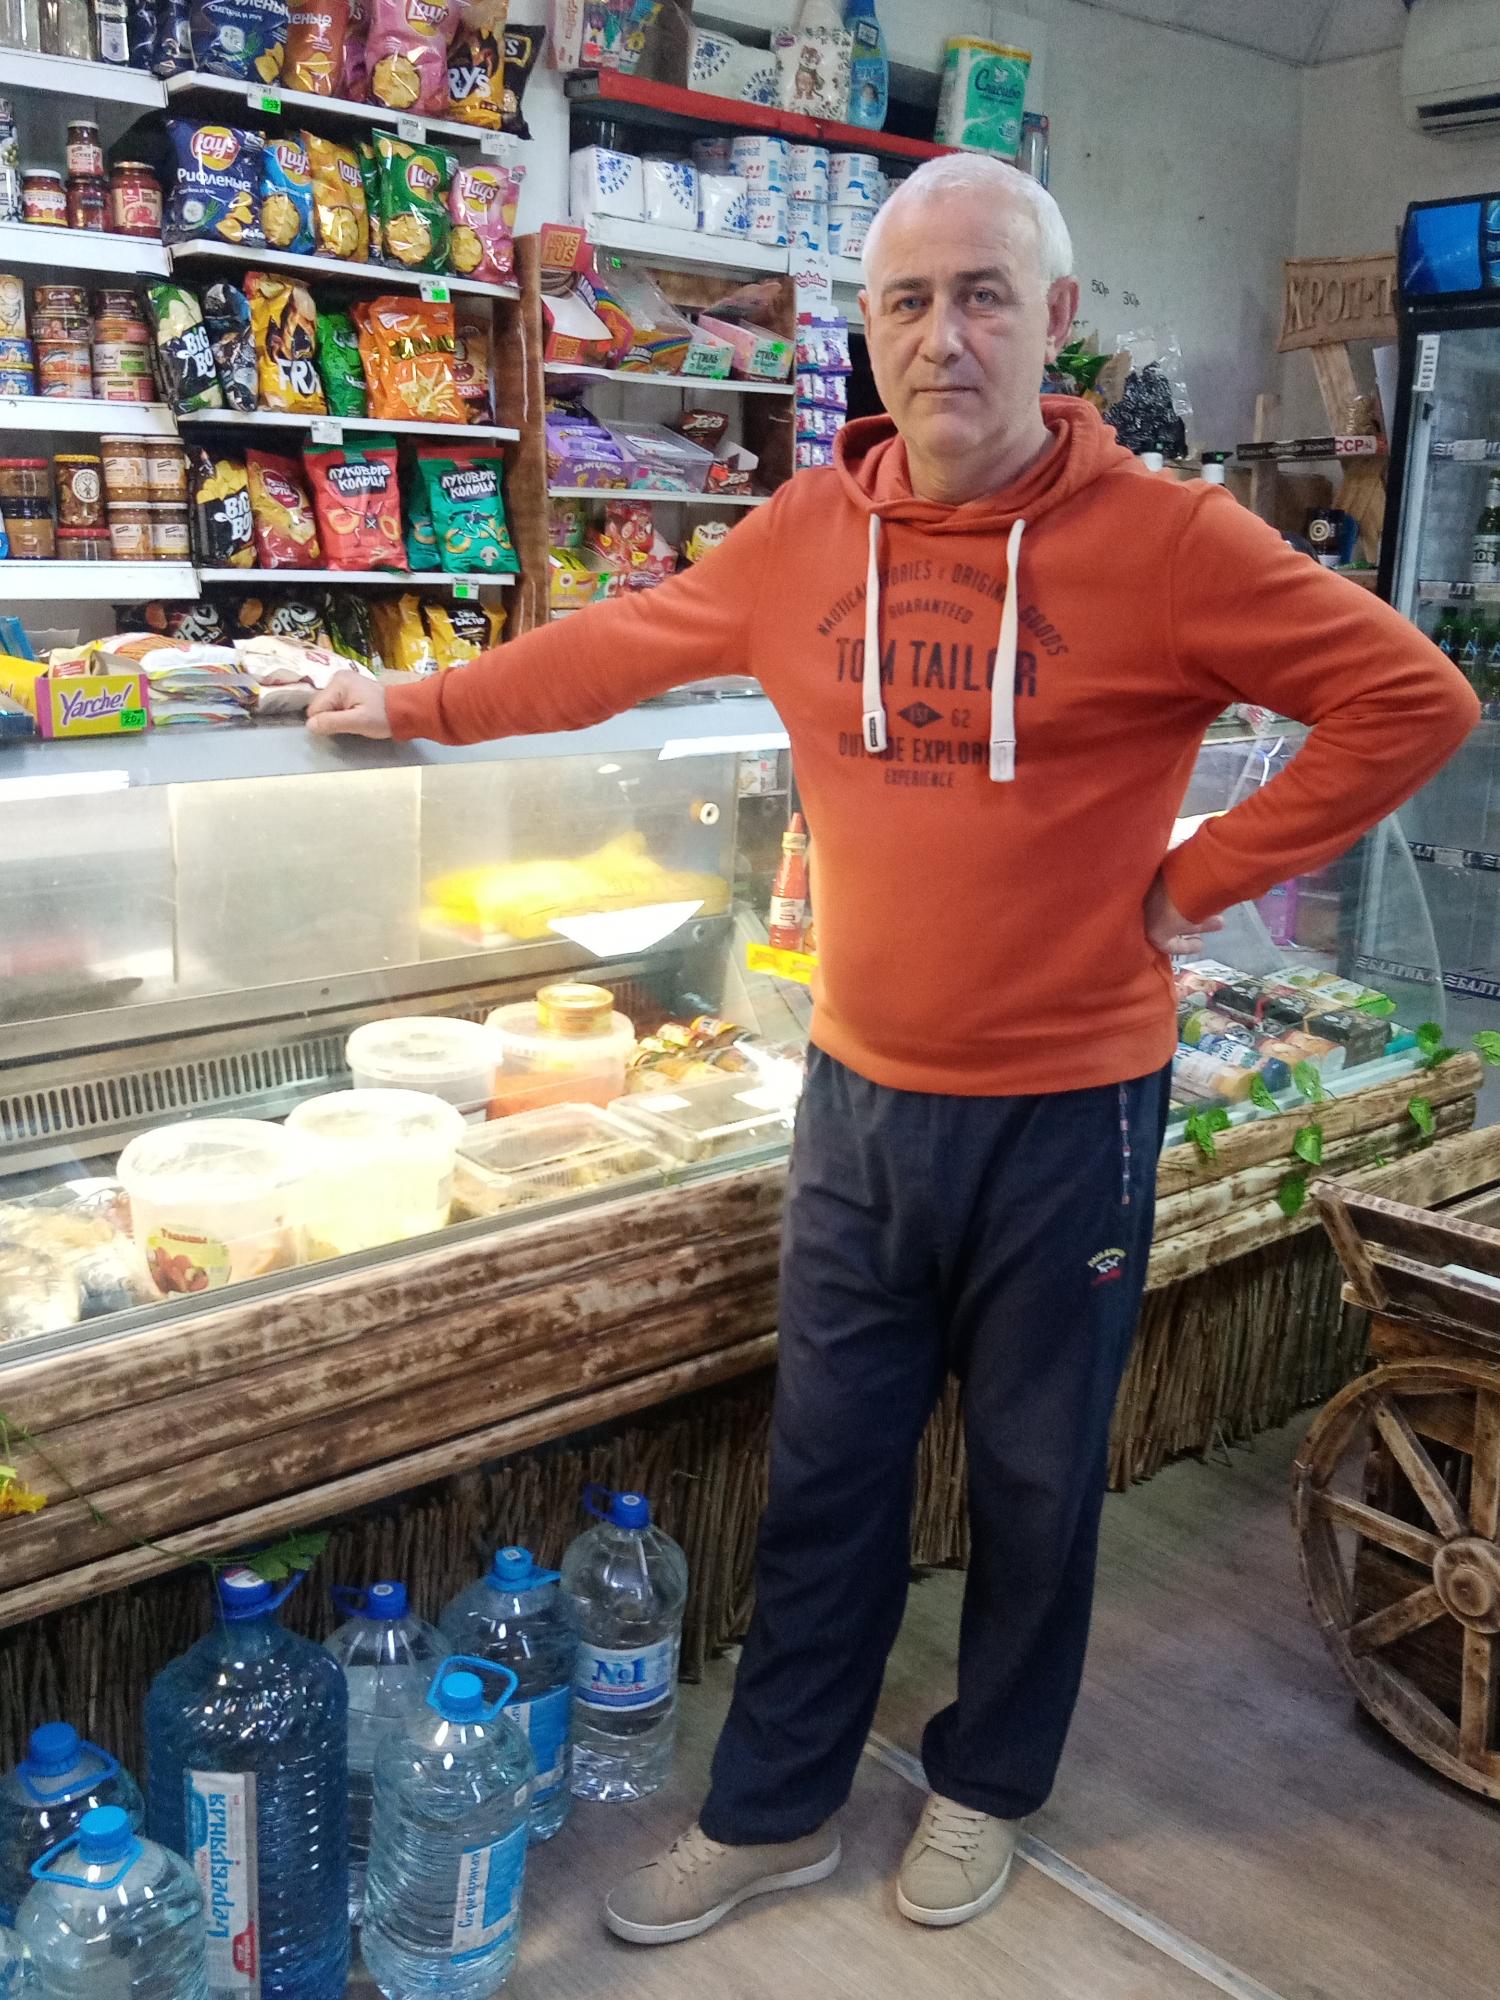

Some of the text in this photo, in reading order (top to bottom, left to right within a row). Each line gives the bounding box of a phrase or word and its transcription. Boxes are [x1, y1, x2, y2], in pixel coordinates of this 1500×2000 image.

[328, 464, 391, 482] ЛУКОВЫЕ
[338, 475, 387, 492] КОЛЬЦА
[441, 469, 497, 489] ЛУКОВЫЕ
[449, 482, 497, 499] КОЛЬЦА
[888, 598, 974, 624] GUARANTEED
[1019, 604, 1070, 656] GOODS
[59, 683, 133, 726] Yarche!
[951, 708, 971, 729] 62
[884, 767, 954, 789] EXPERIENCE
[591, 1656, 647, 1685] №1
